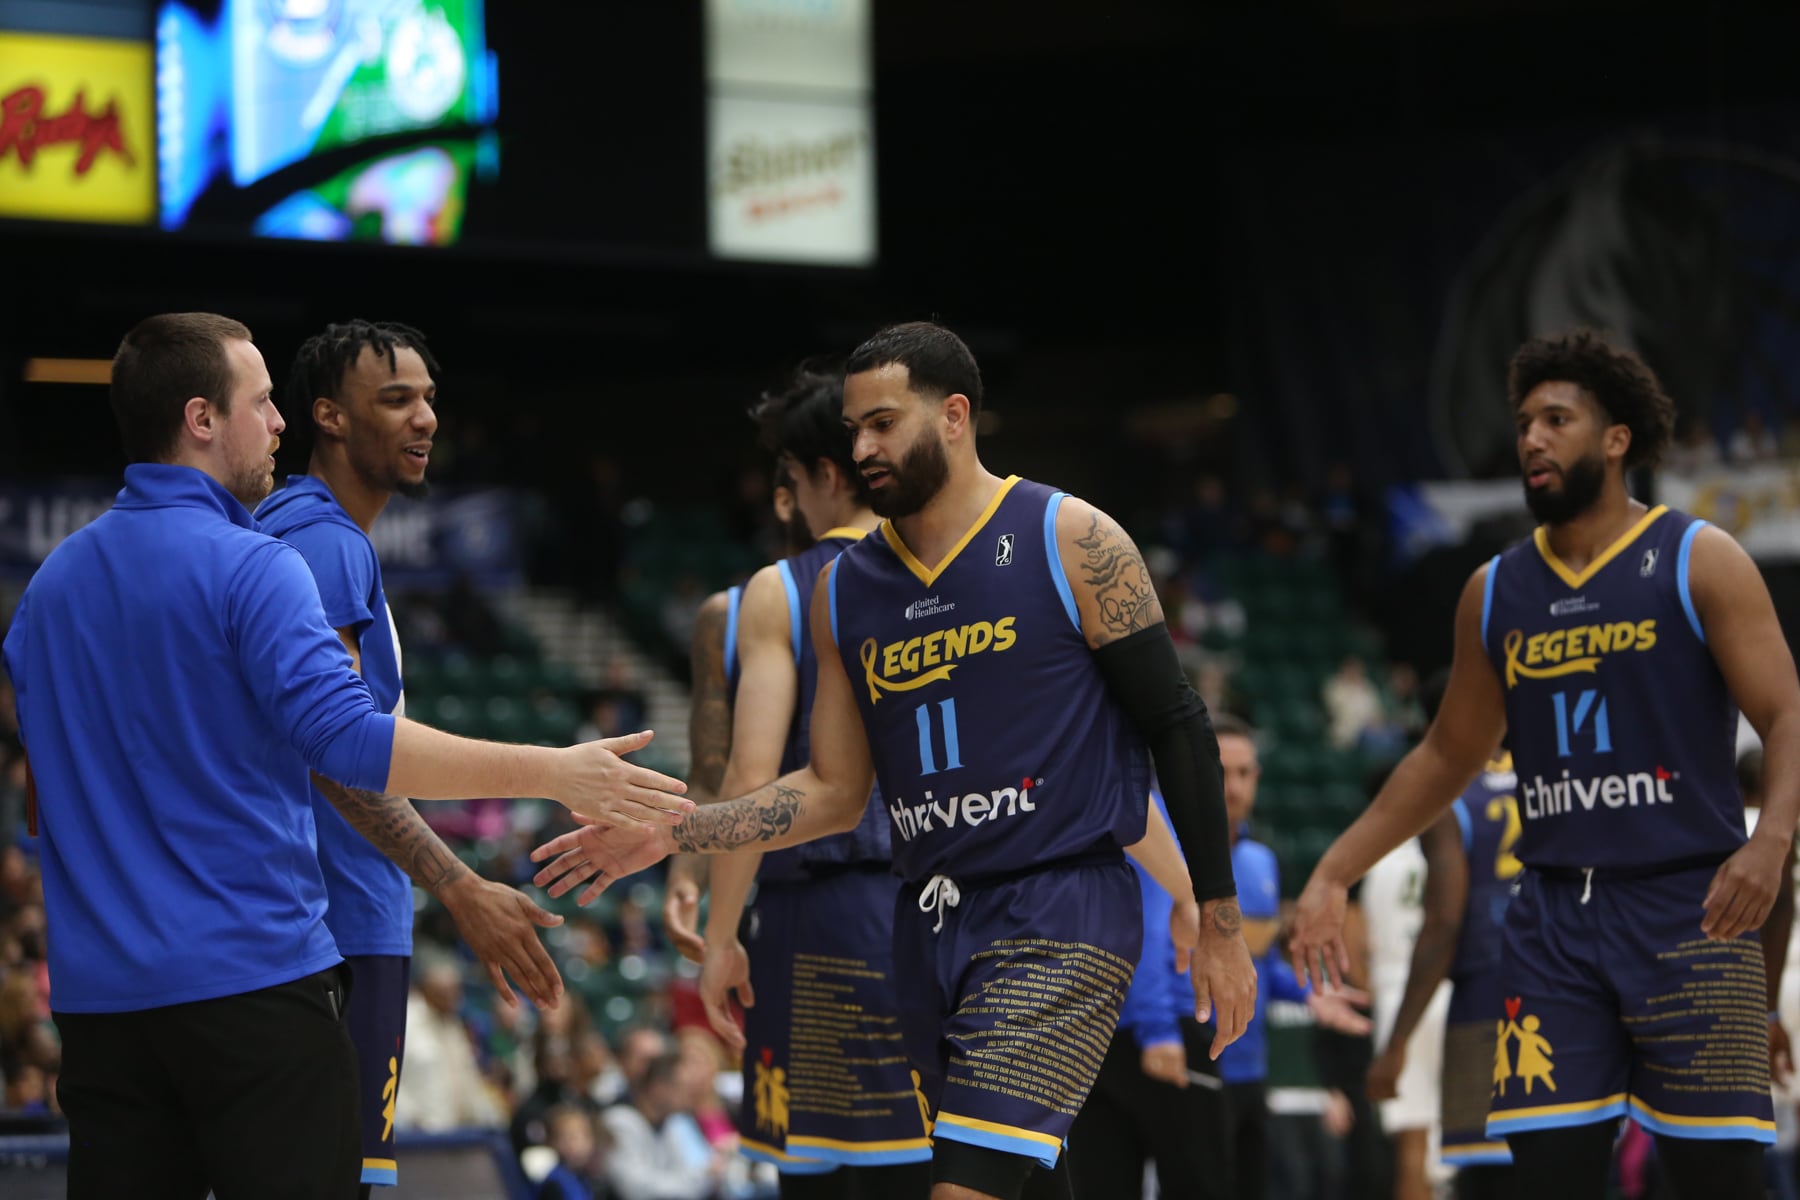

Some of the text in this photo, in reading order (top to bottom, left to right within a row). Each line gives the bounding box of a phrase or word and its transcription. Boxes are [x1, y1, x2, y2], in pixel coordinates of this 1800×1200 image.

[914, 594, 940, 609] United
[914, 602, 956, 620] Healthcare
[860, 616, 1017, 705] LEGENDS
[1504, 619, 1656, 689] LEGENDS
[915, 697, 965, 776] 11
[1552, 689, 1613, 757] 14
